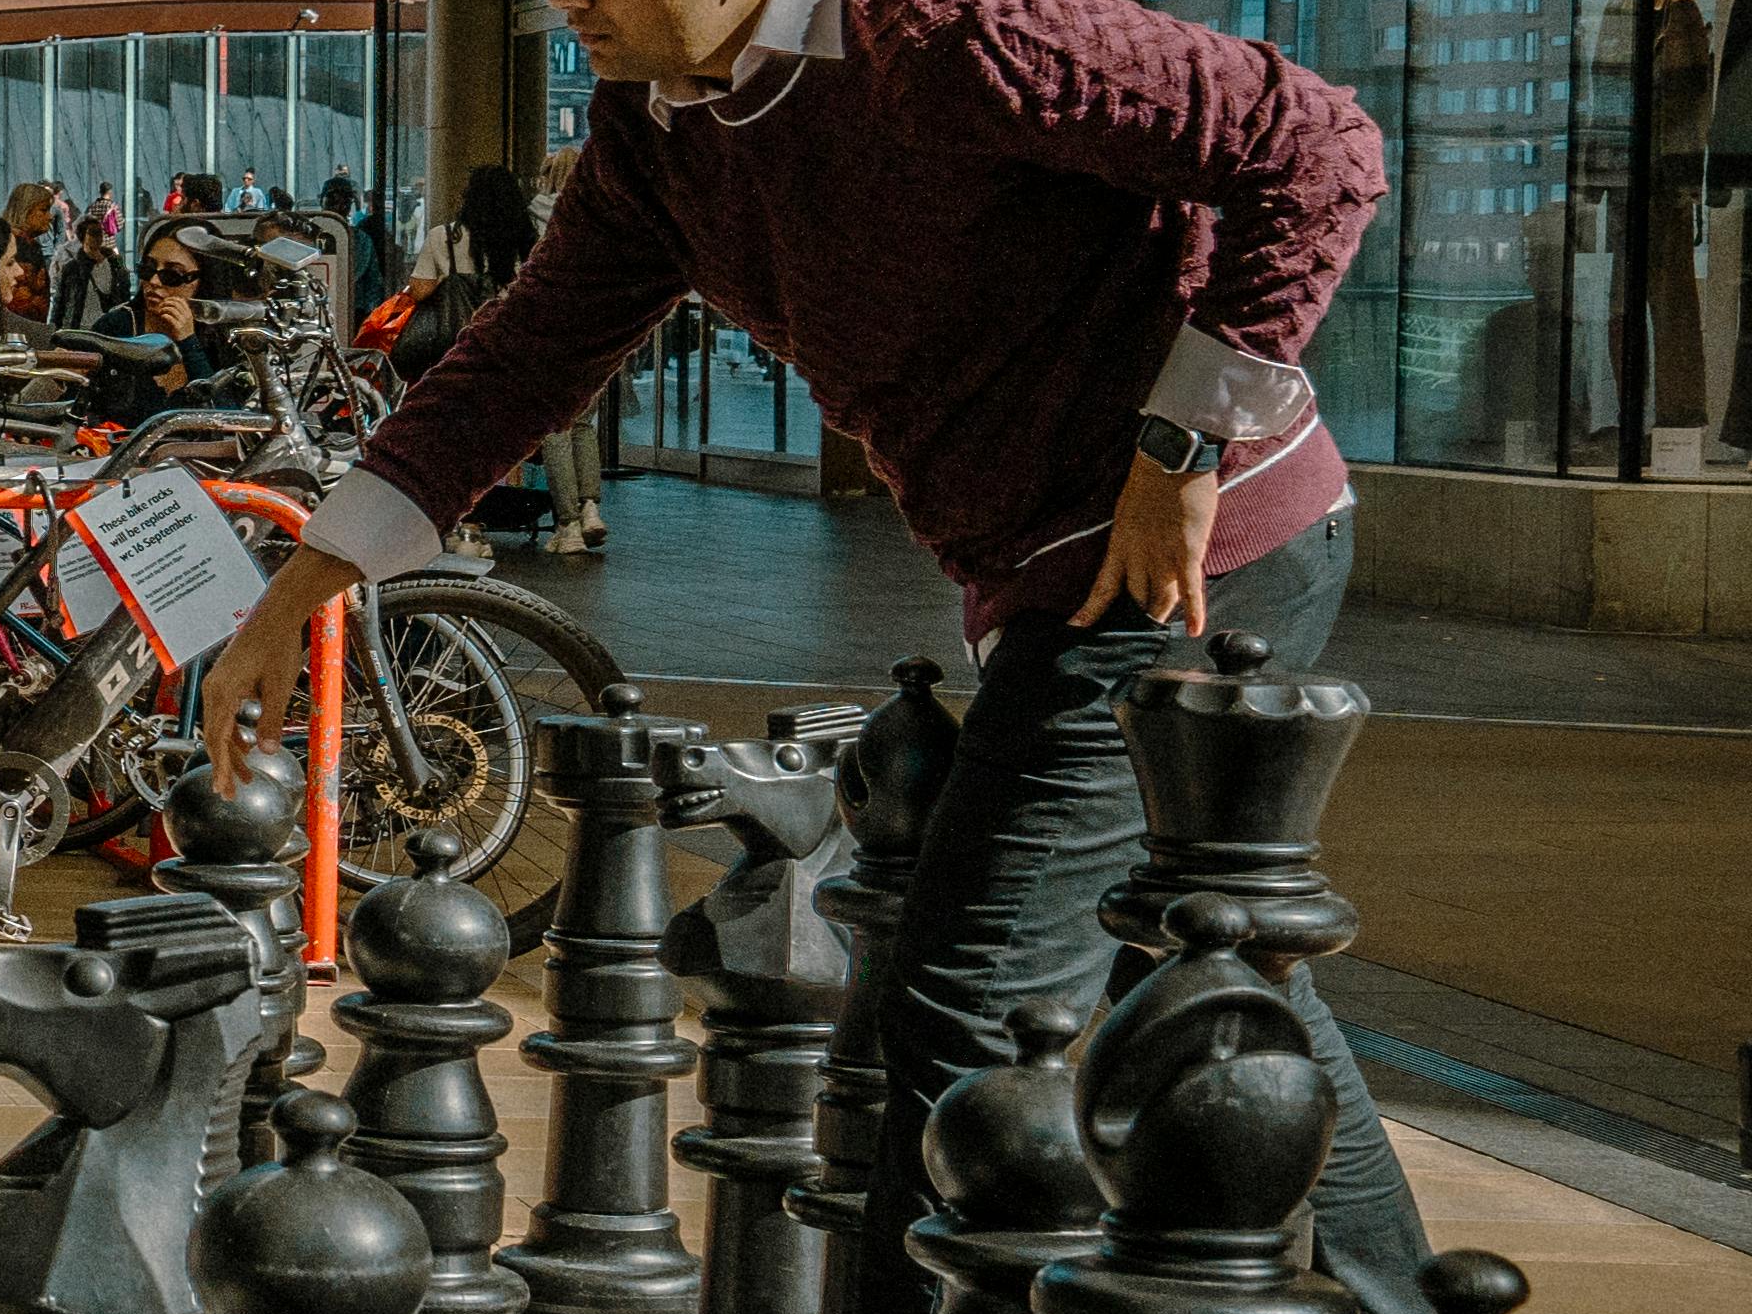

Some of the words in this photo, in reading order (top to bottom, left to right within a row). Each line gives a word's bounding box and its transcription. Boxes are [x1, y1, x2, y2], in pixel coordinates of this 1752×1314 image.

[98, 515, 129, 534] These
[125, 500, 149, 519] bike
[147, 487, 174, 506] racks
[109, 531, 129, 548] will
[126, 525, 142, 539] be
[140, 499, 182, 532] replaced
[119, 549, 135, 563] wc
[132, 542, 145, 555] 16
[143, 513, 199, 548] September.
